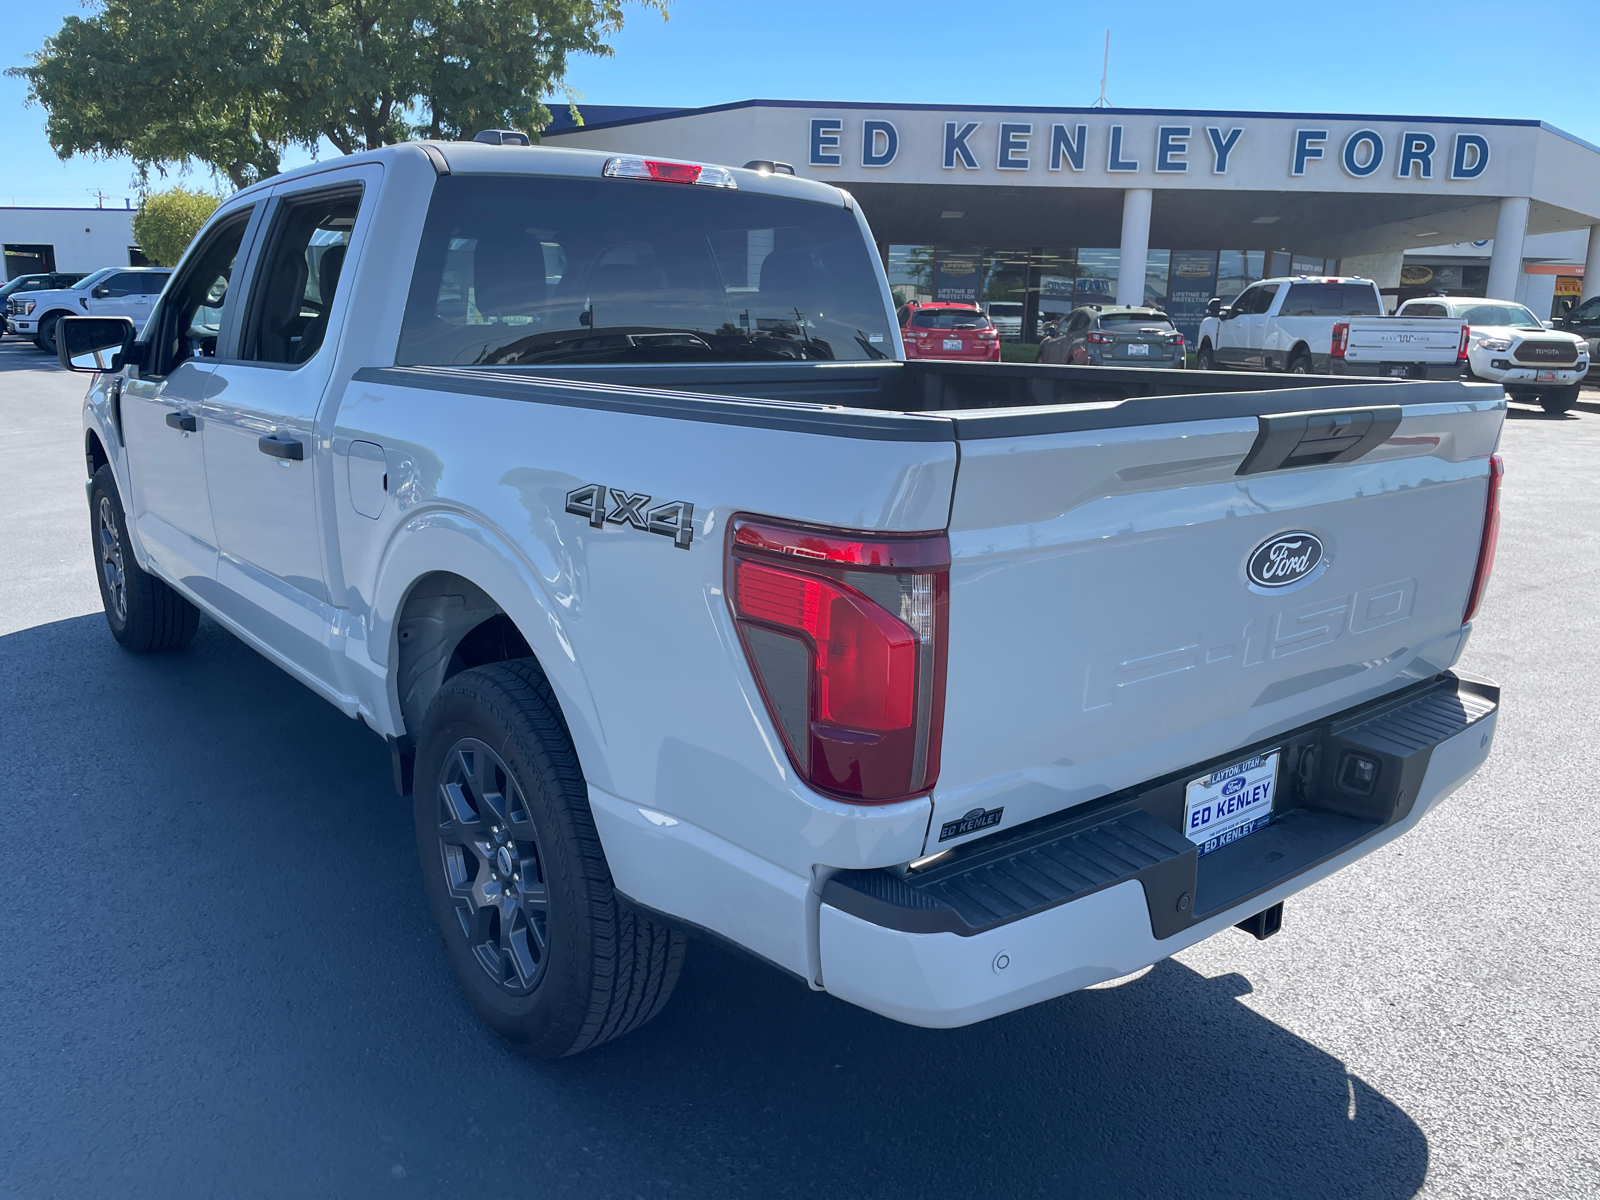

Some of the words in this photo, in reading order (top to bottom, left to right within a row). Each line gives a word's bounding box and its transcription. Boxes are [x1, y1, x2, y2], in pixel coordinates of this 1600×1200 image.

[809, 117, 899, 168] ED
[942, 121, 1245, 175] KENLEY
[1289, 127, 1490, 180] FORD
[1262, 540, 1312, 579] Ford
[1083, 577, 1419, 712] F-150
[1242, 757, 1260, 772] UTAH
[940, 825, 957, 838] ED
[958, 811, 1002, 833] KENLEY
[1191, 806, 1212, 829] ED
[1216, 781, 1271, 819] KENLEY
[1204, 838, 1219, 853] ED
[1219, 820, 1256, 846] KENLEY
